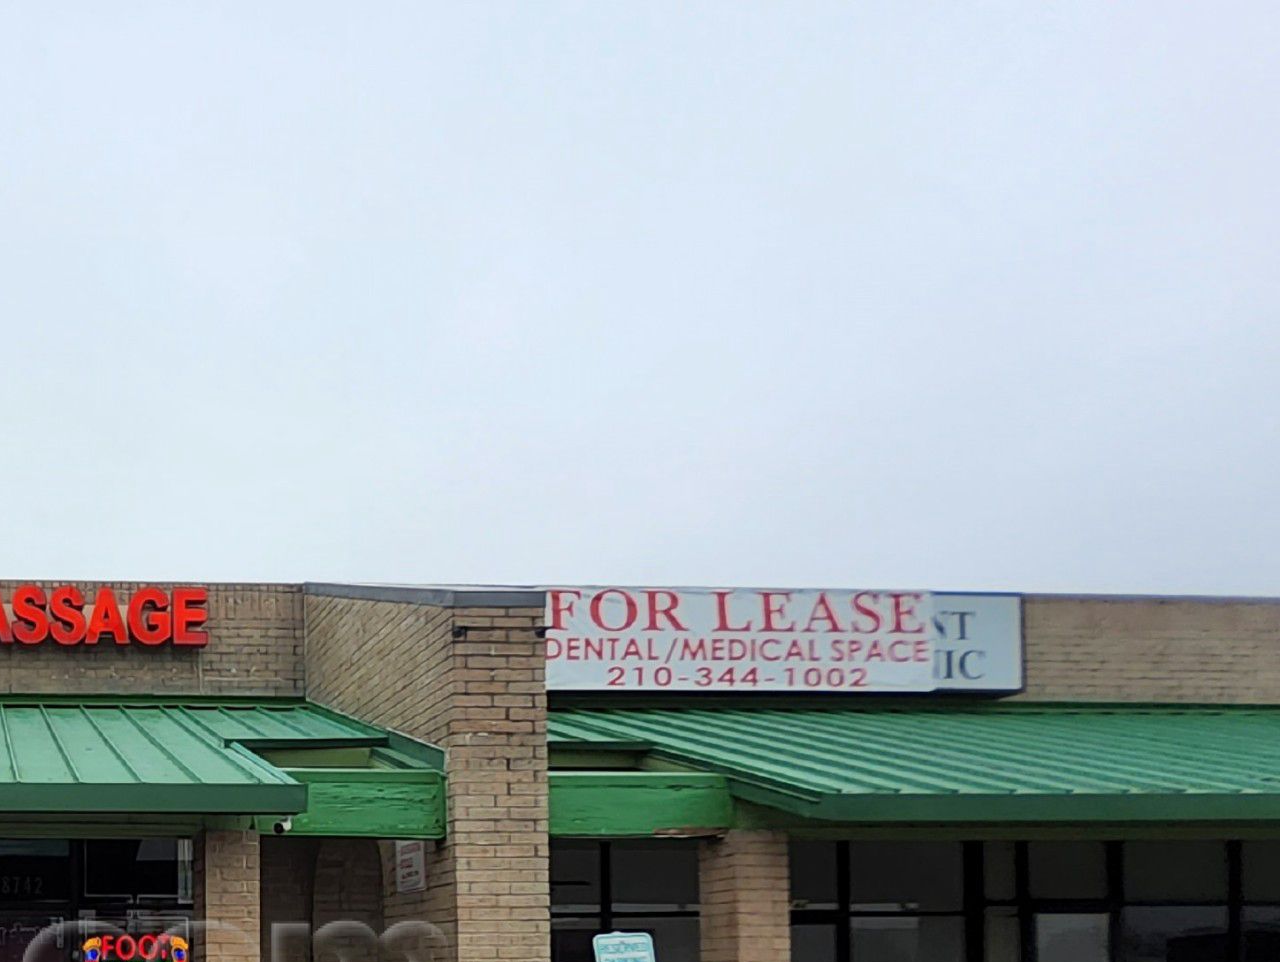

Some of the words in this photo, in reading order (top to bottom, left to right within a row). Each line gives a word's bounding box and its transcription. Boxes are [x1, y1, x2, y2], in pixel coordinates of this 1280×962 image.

[548, 588, 691, 632] FOR
[710, 589, 925, 634] LEASE
[545, 637, 822, 665] DENTAL/MEDICAL
[829, 638, 931, 663] SPACE
[932, 649, 987, 681] IC
[606, 666, 870, 688] 210-344-1002
[1, 875, 44, 895] 8742
[100, 933, 171, 961] FOOT
